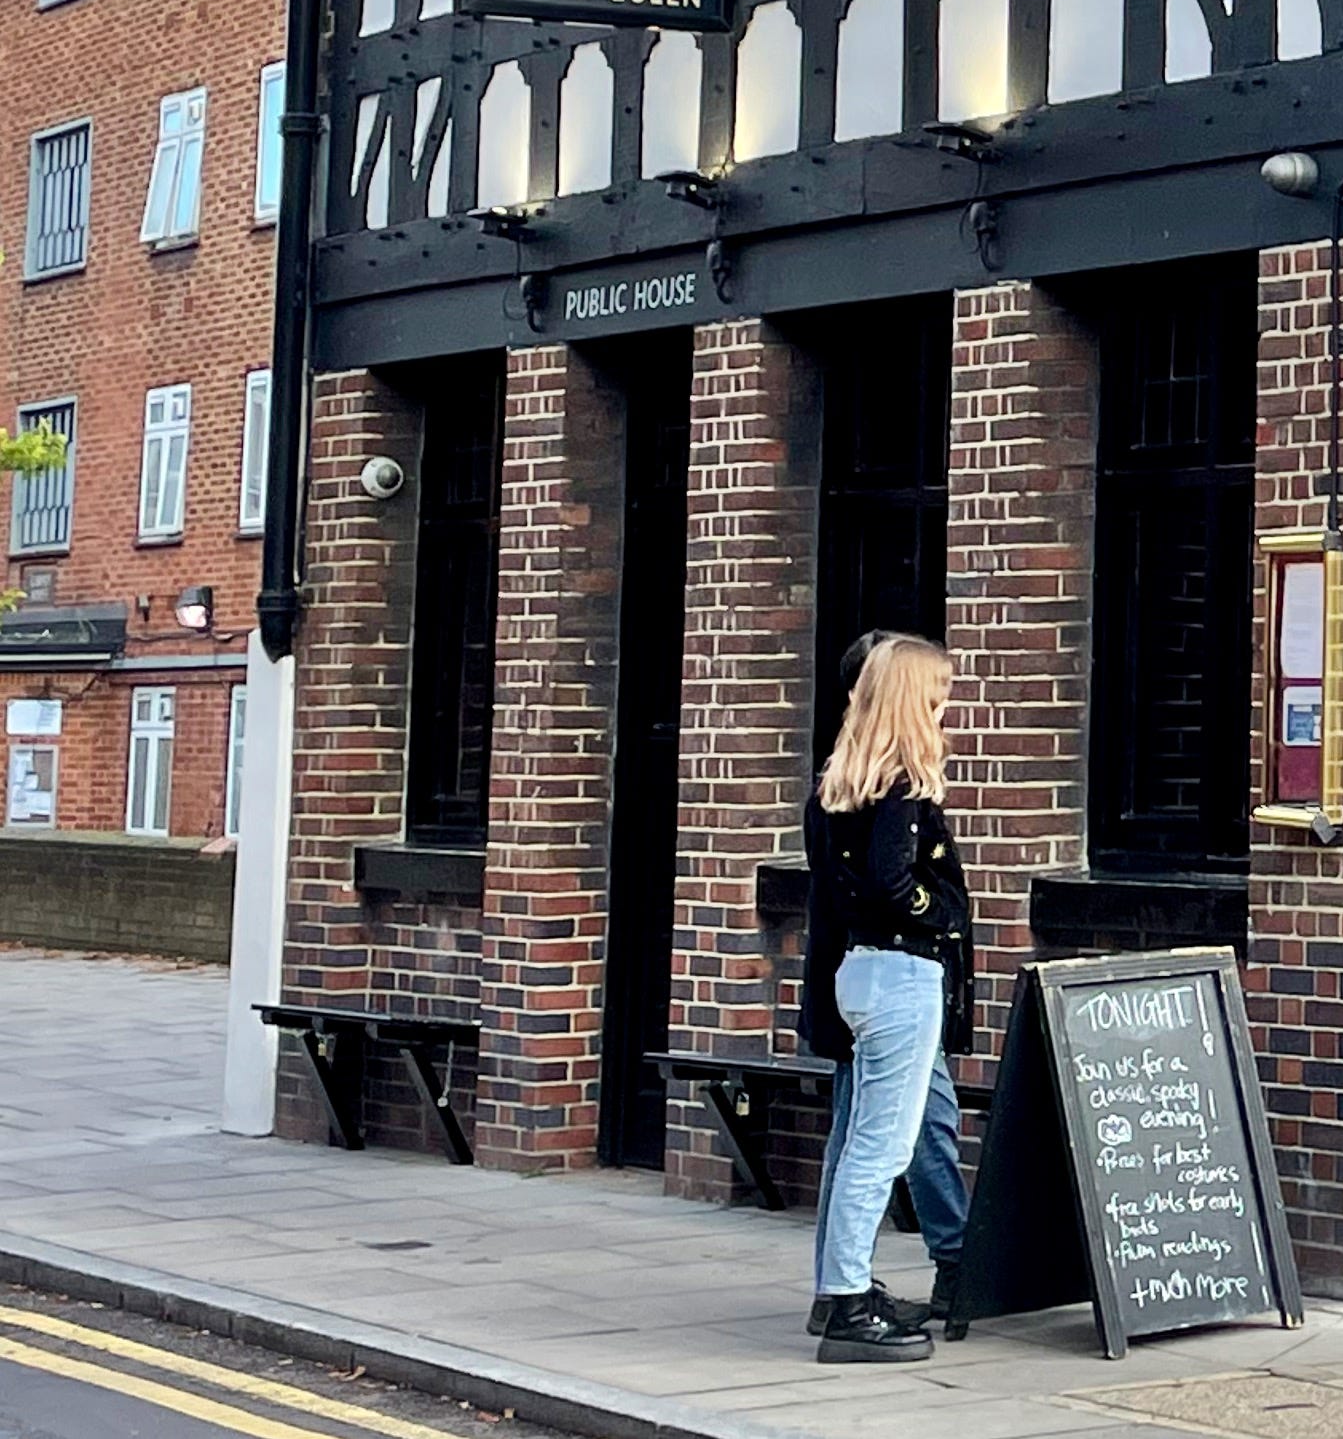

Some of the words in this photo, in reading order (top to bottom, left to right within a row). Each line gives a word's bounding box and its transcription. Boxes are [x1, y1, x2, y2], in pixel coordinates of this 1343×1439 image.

[565, 282, 628, 321] PUBLIC
[633, 273, 696, 311] HOUSE
[1169, 1056, 1190, 1073] a
